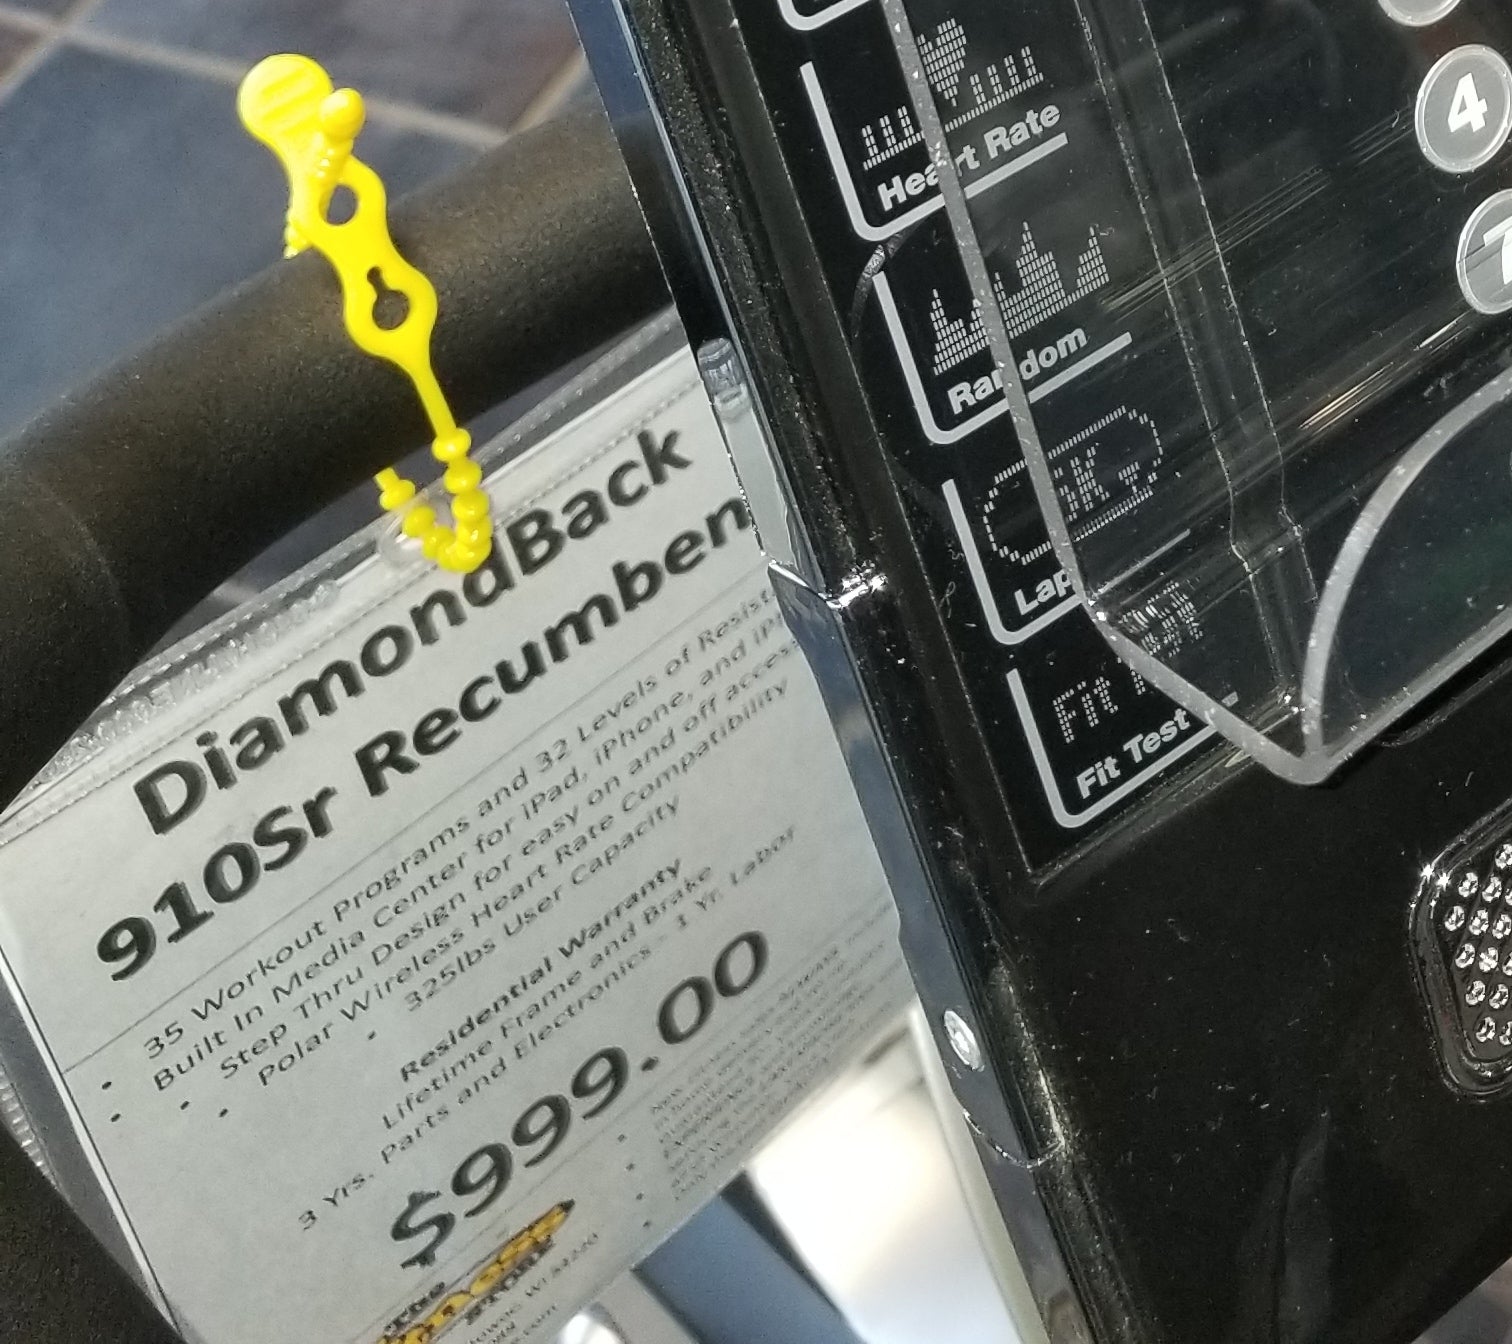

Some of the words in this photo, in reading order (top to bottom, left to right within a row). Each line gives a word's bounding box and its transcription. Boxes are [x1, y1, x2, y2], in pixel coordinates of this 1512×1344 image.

[877, 143, 981, 213] Heart
[982, 103, 1062, 160] Rate
[1446, 71, 1489, 134] 4
[95, 784, 340, 983] 910Sr
[353, 495, 753, 798] Recumben
[133, 428, 694, 837] DiamondBack
[1075, 754, 1122, 801] Fit
[1122, 707, 1192, 764] Test
[142, 1020, 184, 1061] 35
[190, 917, 328, 1022] Workout
[332, 816, 471, 923] Programs
[476, 765, 529, 818] and
[534, 738, 573, 774] 32
[576, 674, 657, 744] Levels
[664, 644, 691, 678] of
[152, 1028, 228, 1092] Built
[232, 1002, 265, 1032] In
[271, 928, 366, 1004] Media
[372, 850, 469, 930] Center
[473, 818, 517, 856] for
[592, 689, 695, 767] iPhone,
[699, 637, 748, 688] and
[219, 1021, 289, 1081] Step
[293, 963, 364, 1021] Thru
[370, 889, 468, 967] Design
[473, 854, 514, 893] for
[520, 804, 580, 859] easy
[587, 773, 622, 807] on
[627, 725, 677, 776] and
[682, 691, 720, 734] off
[256, 1020, 335, 1089] Polar
[340, 928, 465, 1023] Wireless
[470, 862, 549, 929] Heart
[554, 813, 614, 866] Rate
[621, 677, 789, 815] Compatibility
[298, 1208, 319, 1232] 3
[321, 1171, 376, 1207] Yrs.
[380, 1103, 450, 1165] Parts
[456, 1055, 508, 1106] and
[512, 945, 653, 1061] Electronics
[729, 824, 796, 887] Labor
[381, 1039, 494, 1131] Lifetime
[499, 968, 583, 1041] Frame
[589, 919, 638, 971] and
[642, 865, 713, 927] Brake
[399, 955, 553, 1083] Residential
[558, 857, 681, 960] Warranty
[403, 936, 497, 1012] 325lbs
[502, 883, 564, 938] User
[570, 793, 681, 886] Capacity
[389, 928, 771, 1272] $999.00
